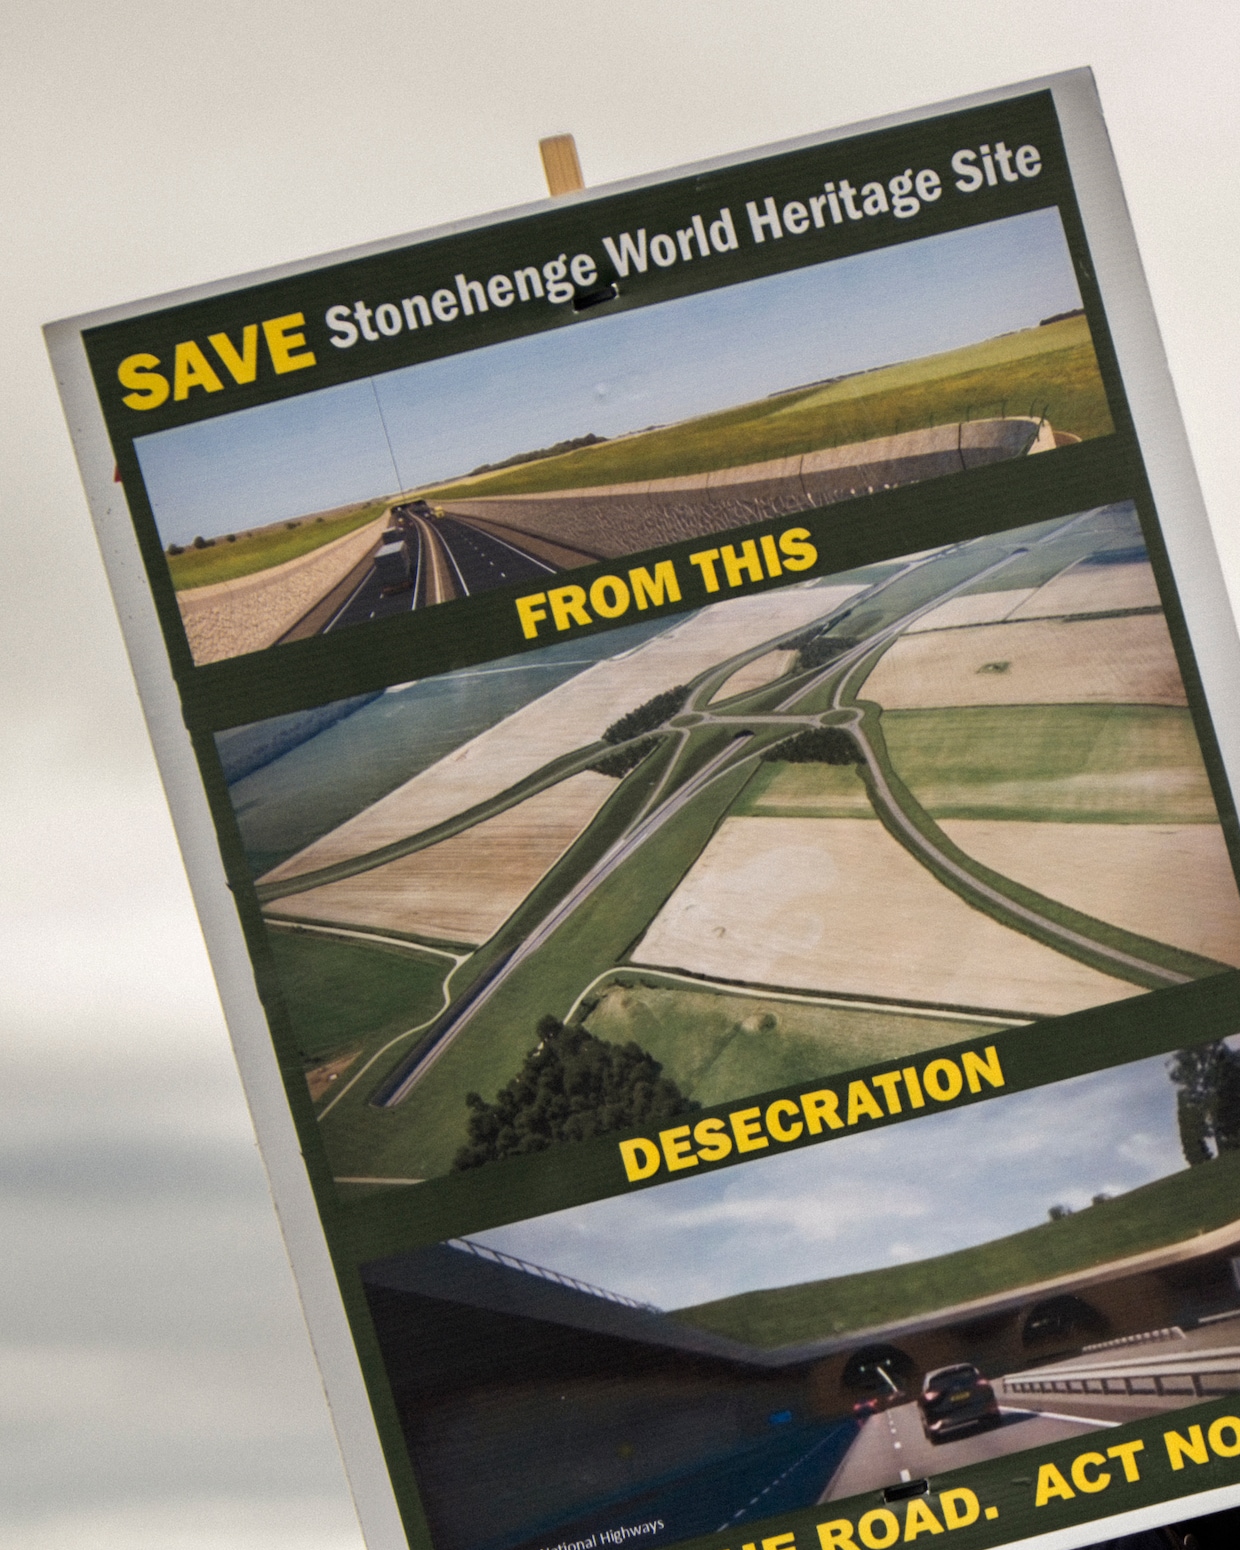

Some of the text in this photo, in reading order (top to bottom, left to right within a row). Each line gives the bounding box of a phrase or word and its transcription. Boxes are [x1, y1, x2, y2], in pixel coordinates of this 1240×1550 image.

[117, 140, 1042, 411] SAVE Stonehenge World Heritage Site
[515, 527, 818, 640] FROM THIS
[619, 1045, 1005, 1182] DESECRATION
[1035, 1439, 1145, 1507] ACT
[600, 1519, 665, 1545] Highways
